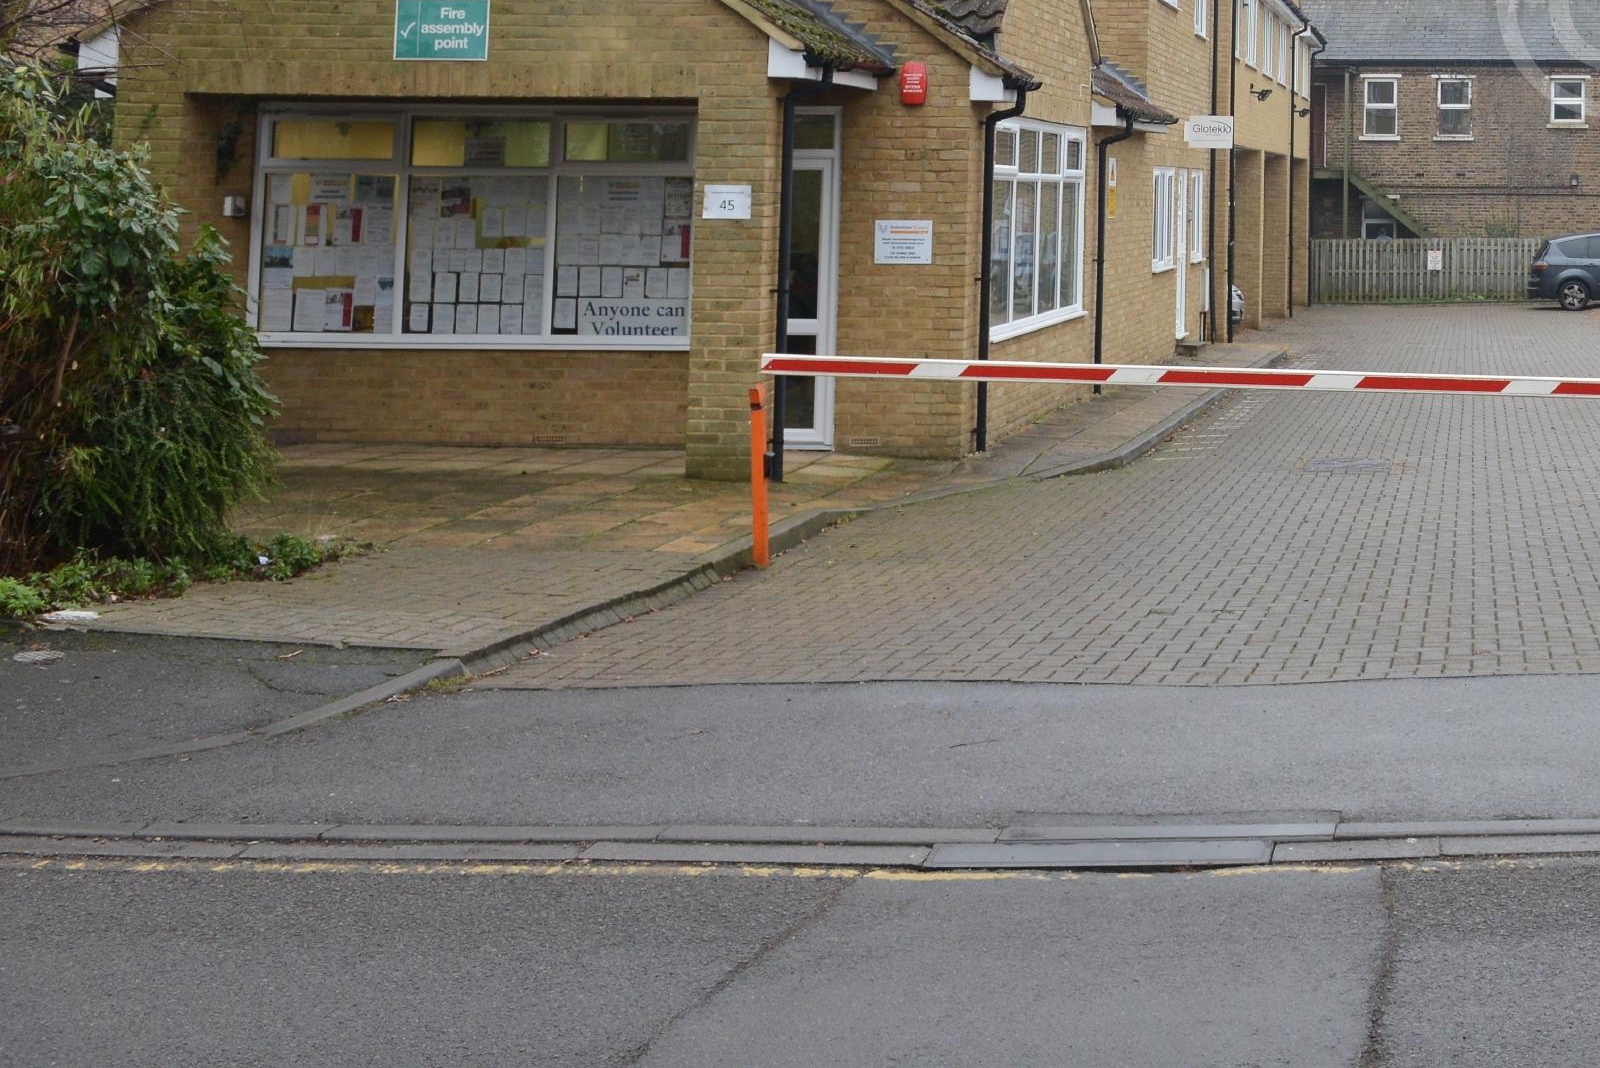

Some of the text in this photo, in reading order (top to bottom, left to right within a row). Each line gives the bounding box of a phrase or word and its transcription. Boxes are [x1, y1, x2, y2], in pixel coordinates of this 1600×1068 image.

[440, 7, 466, 19] Fire
[421, 22, 484, 37] assembly
[434, 37, 469, 51] point
[1192, 123, 1230, 133] Glotekk
[720, 199, 735, 211] 45
[583, 301, 685, 321] Anyone can
[591, 321, 678, 336] Volunteer
